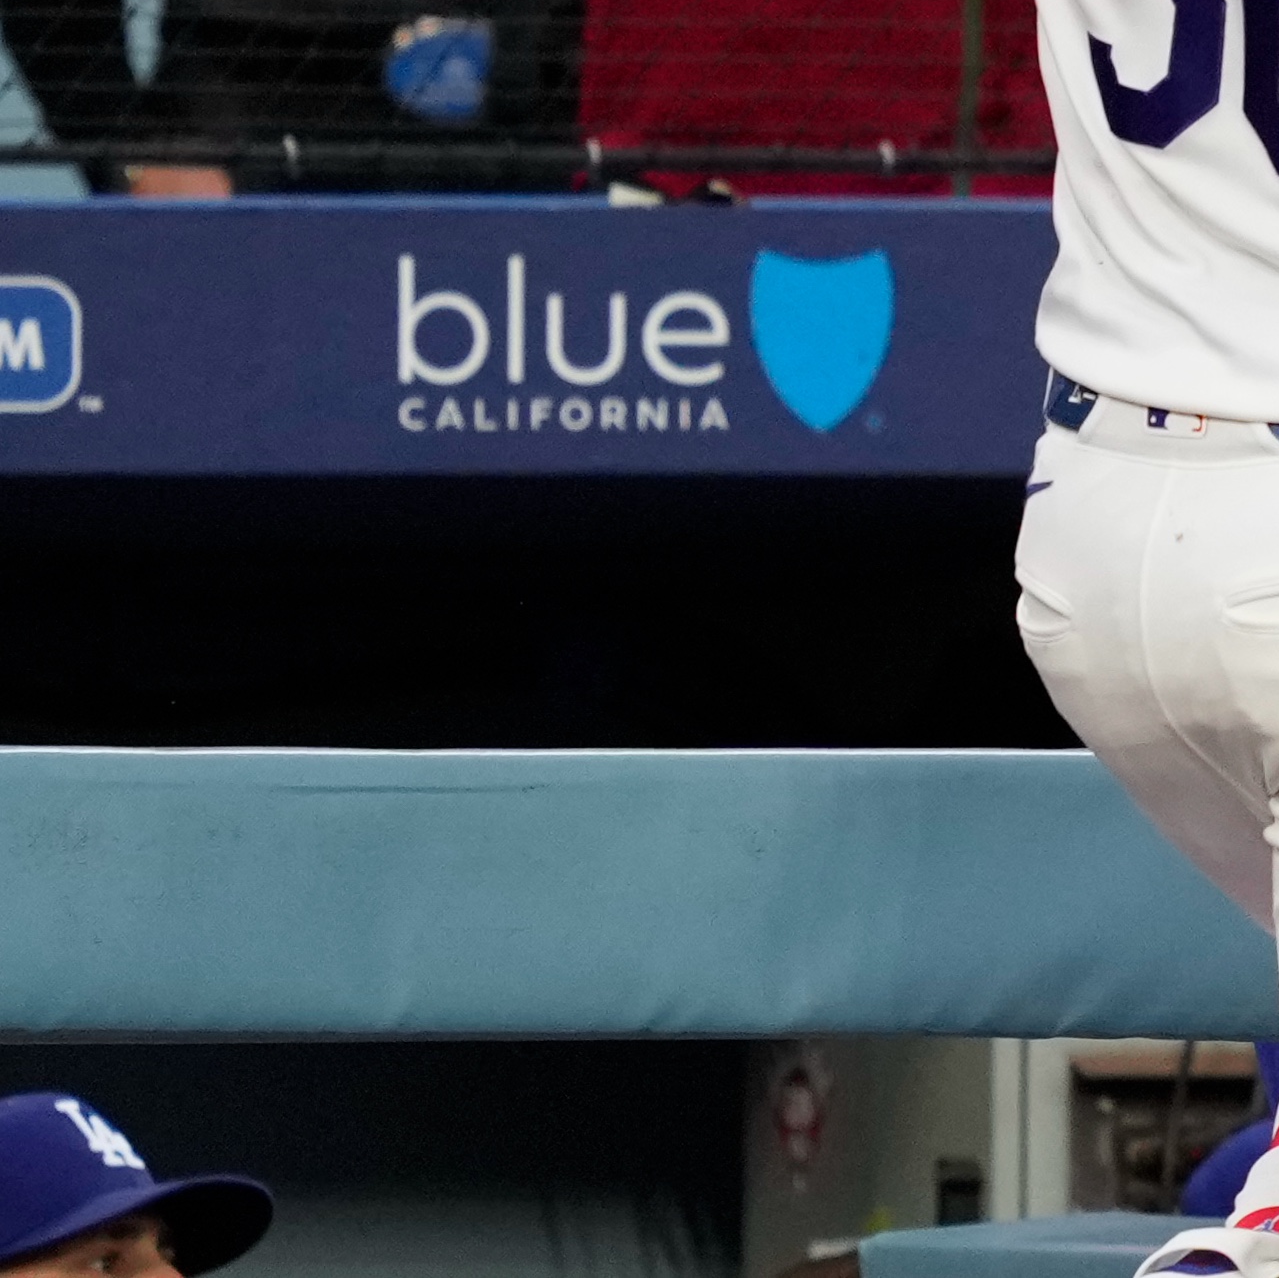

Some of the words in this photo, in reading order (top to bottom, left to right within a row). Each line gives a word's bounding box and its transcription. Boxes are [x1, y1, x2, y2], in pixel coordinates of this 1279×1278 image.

[398, 253, 731, 386] blue
[397, 396, 731, 432] CALIFORNIA
[53, 1098, 146, 1170] LA
